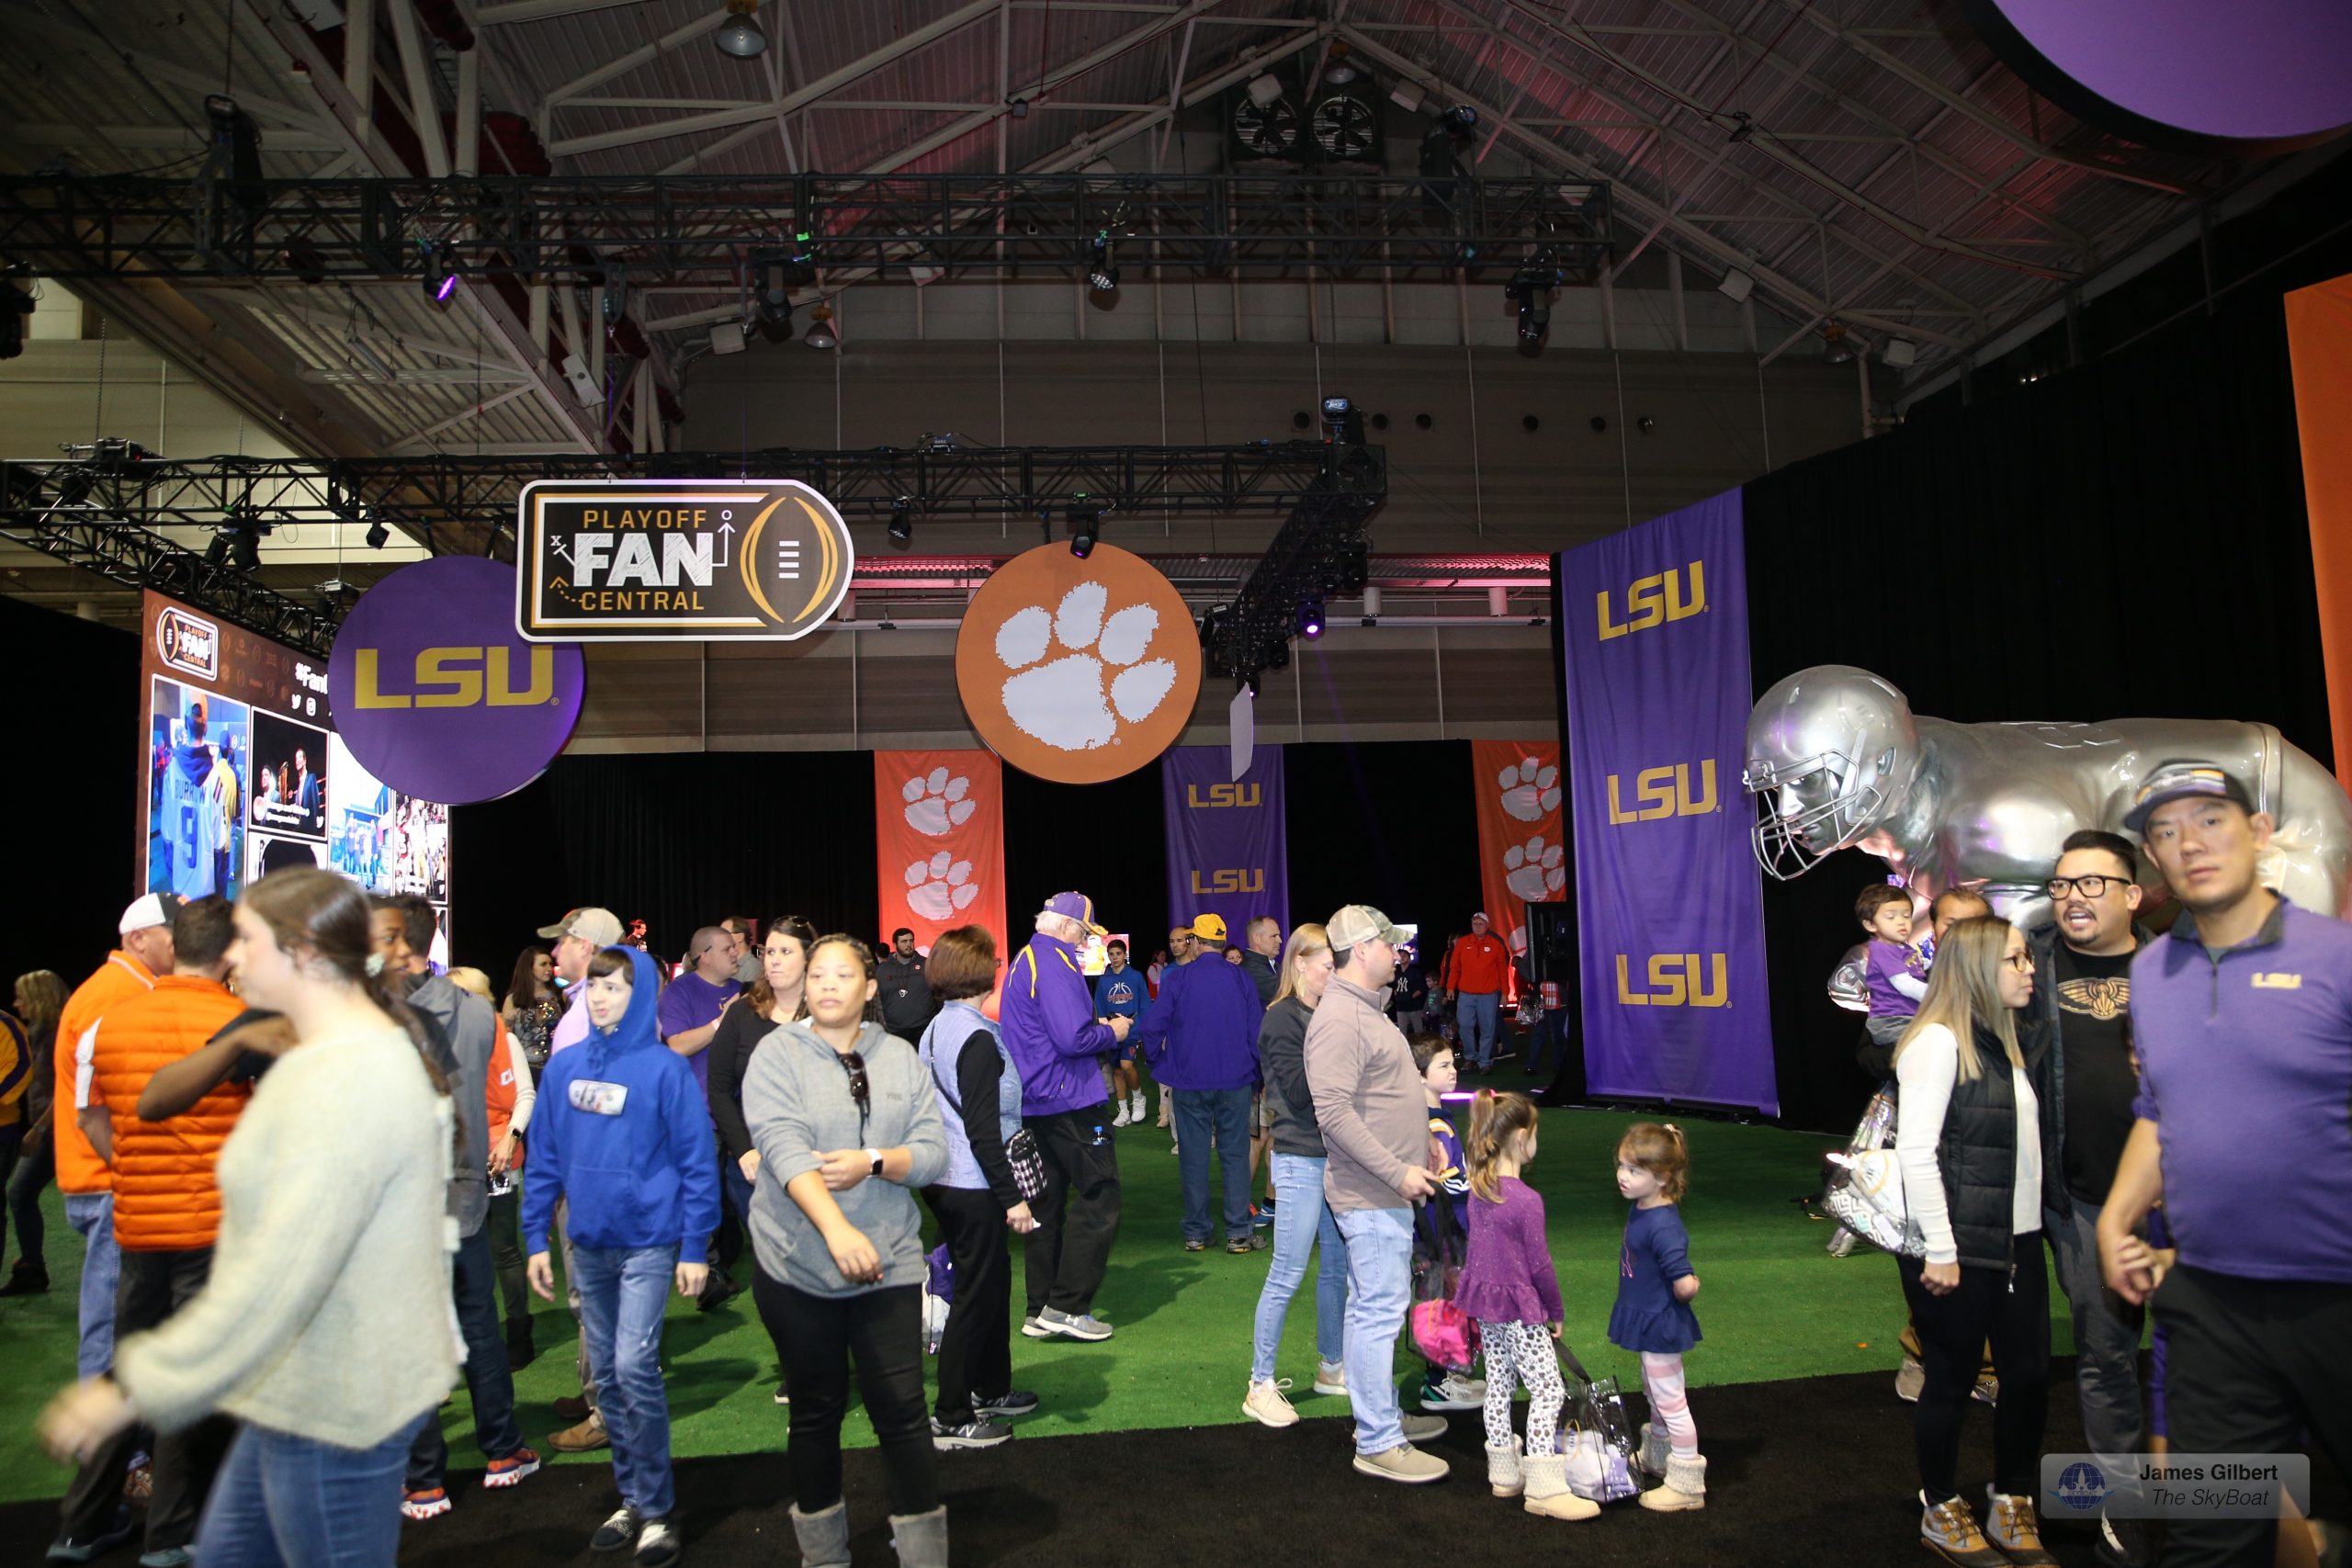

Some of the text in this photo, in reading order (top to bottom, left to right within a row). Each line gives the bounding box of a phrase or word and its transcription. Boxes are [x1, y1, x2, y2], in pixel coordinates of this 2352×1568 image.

[582, 509, 707, 529] PLAYOFF
[573, 532, 714, 587] FAN
[582, 591, 705, 611] CENTRAL
[1597, 559, 1706, 641] LSU
[182, 631, 209, 660] FAN
[184, 624, 208, 639] PLAYOFF
[184, 652, 207, 668] CENTRAL
[355, 645, 553, 709] LSU
[1188, 783, 1261, 807] LSU
[1607, 759, 1717, 825] LSU
[181, 806, 198, 869] 9
[1191, 868, 1264, 894] LSU
[1616, 953, 1728, 1008] LSU
